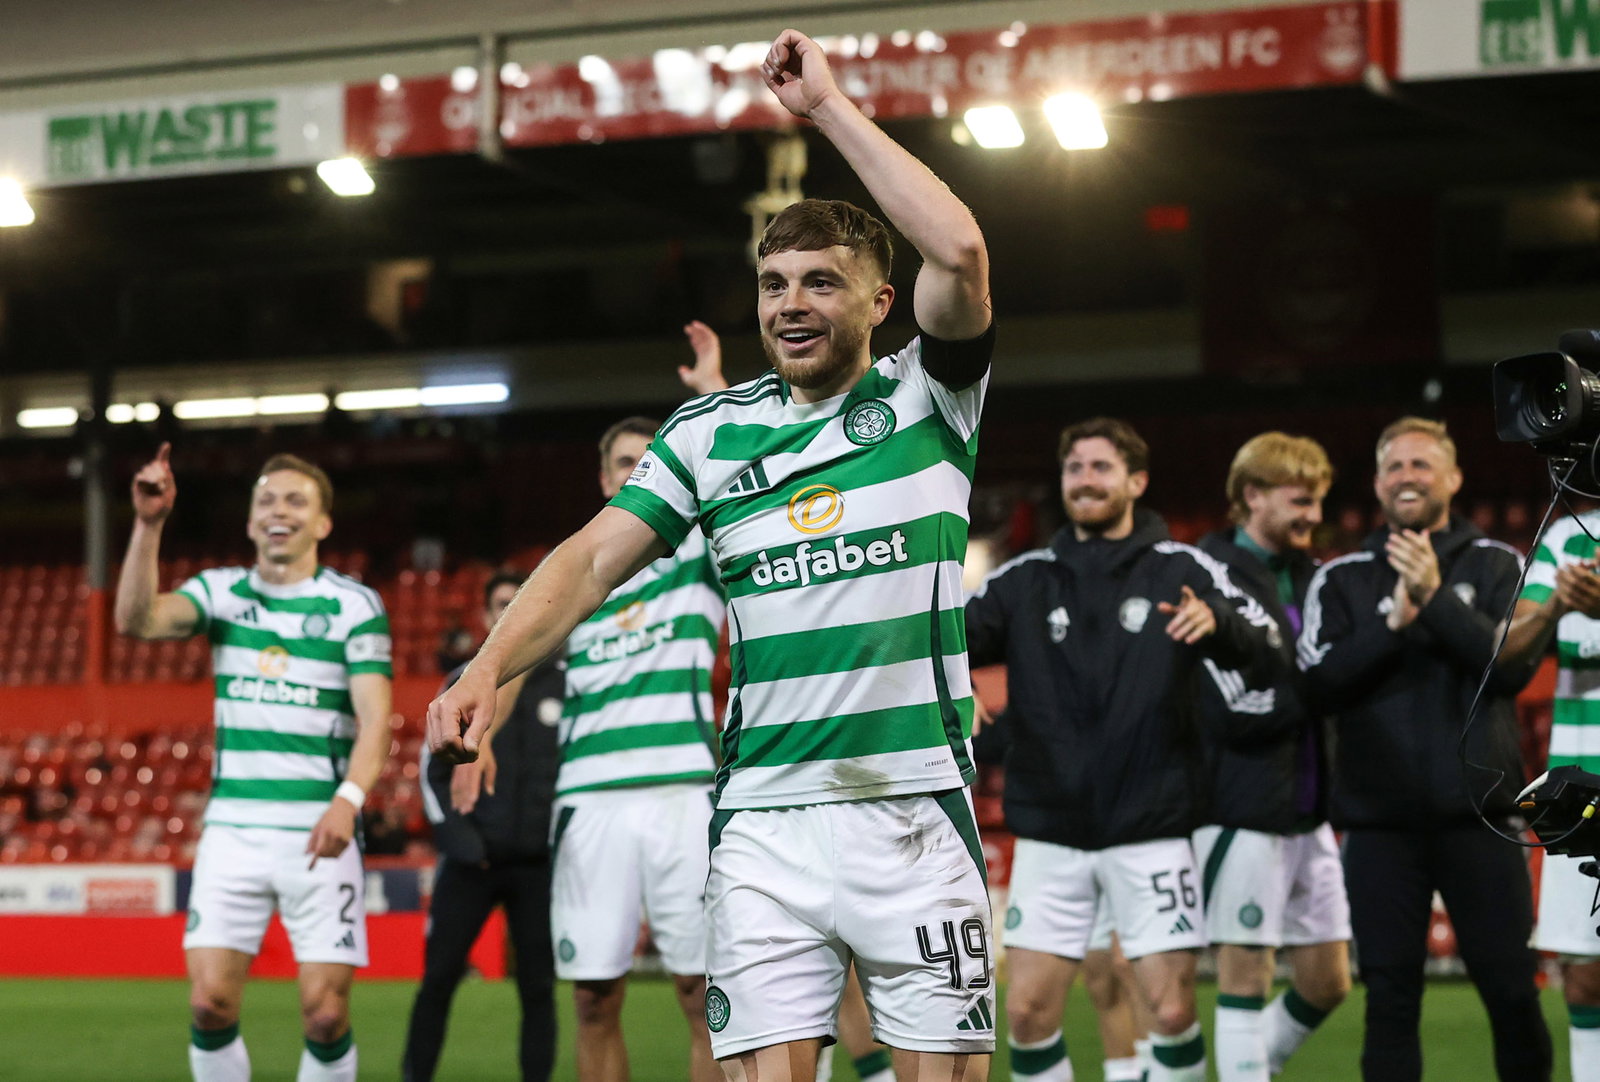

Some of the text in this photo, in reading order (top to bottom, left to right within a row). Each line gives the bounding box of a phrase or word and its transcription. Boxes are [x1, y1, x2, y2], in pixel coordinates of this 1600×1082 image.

[1228, 26, 1281, 68] FC
[100, 99, 277, 168] WASTE
[750, 529, 908, 587] dafabet
[226, 676, 319, 707] dafabet
[338, 883, 356, 924] 2
[1150, 868, 1197, 913] 56
[914, 917, 991, 990] 49
